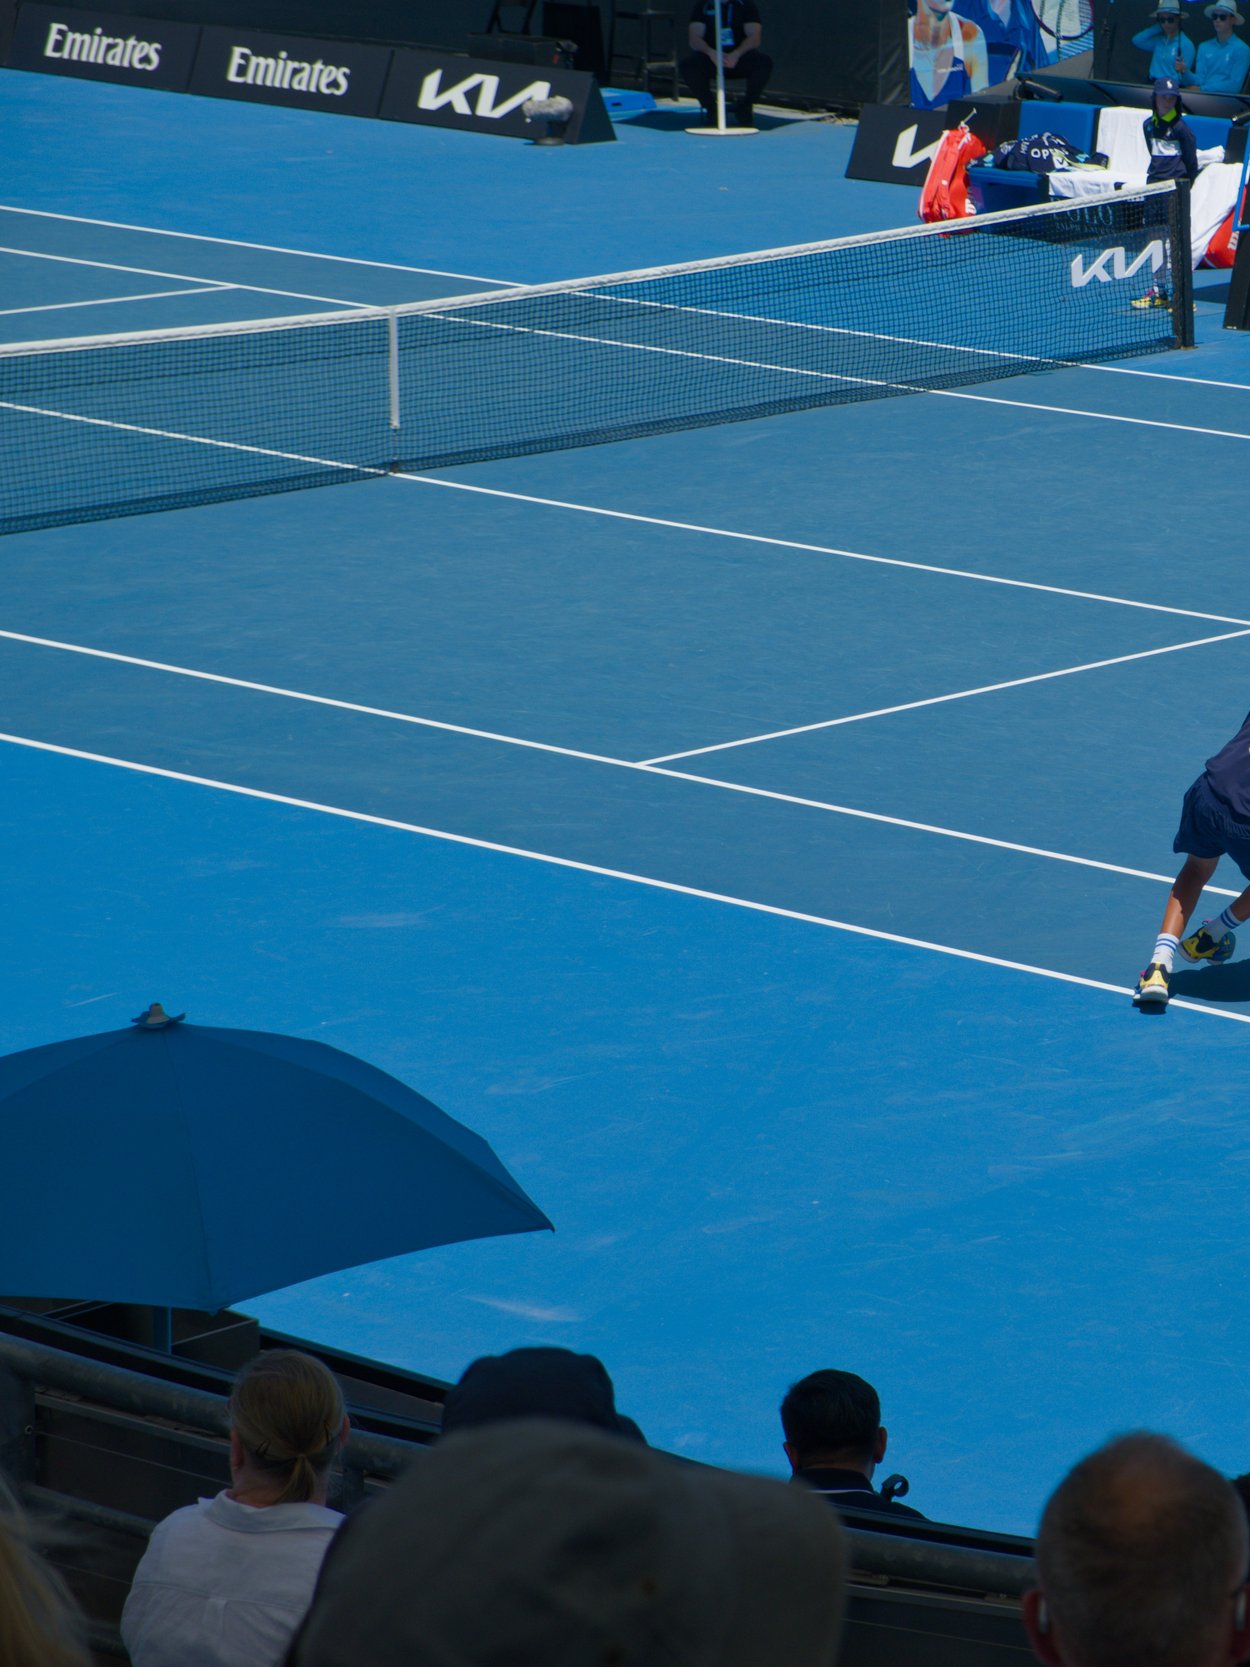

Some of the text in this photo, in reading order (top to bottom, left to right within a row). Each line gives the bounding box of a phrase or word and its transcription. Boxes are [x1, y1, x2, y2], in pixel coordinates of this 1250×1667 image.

[44, 22, 162, 71] Emirates
[226, 46, 350, 96] Emirates
[1071, 239, 1163, 288] KIA
